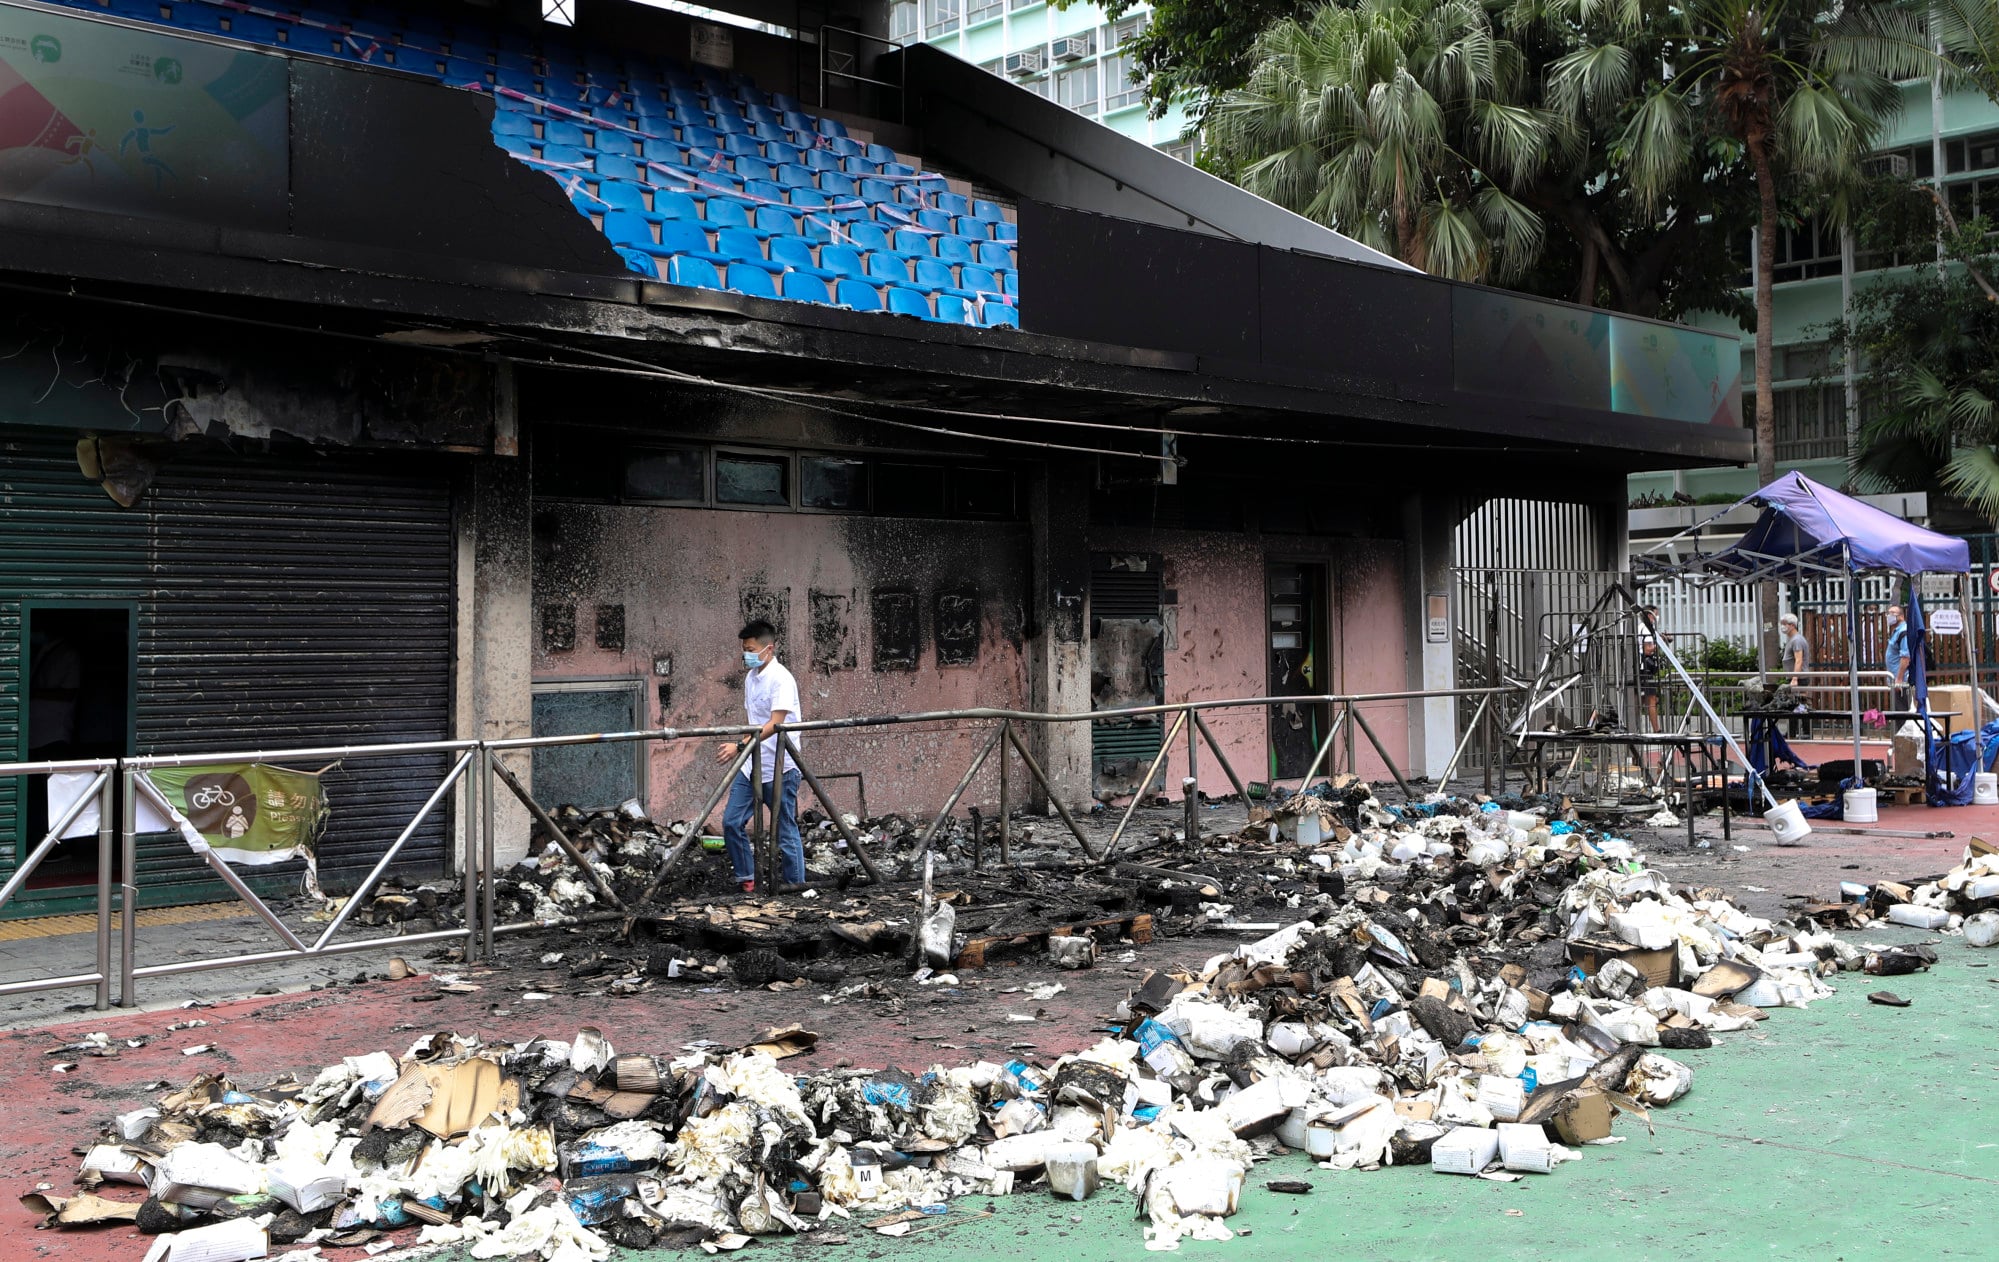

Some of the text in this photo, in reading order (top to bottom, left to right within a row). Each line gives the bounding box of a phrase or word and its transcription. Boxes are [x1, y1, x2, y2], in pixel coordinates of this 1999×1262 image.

[279, 1101, 289, 1112] M
[860, 1170, 872, 1182] M
[643, 1186, 656, 1199] M
